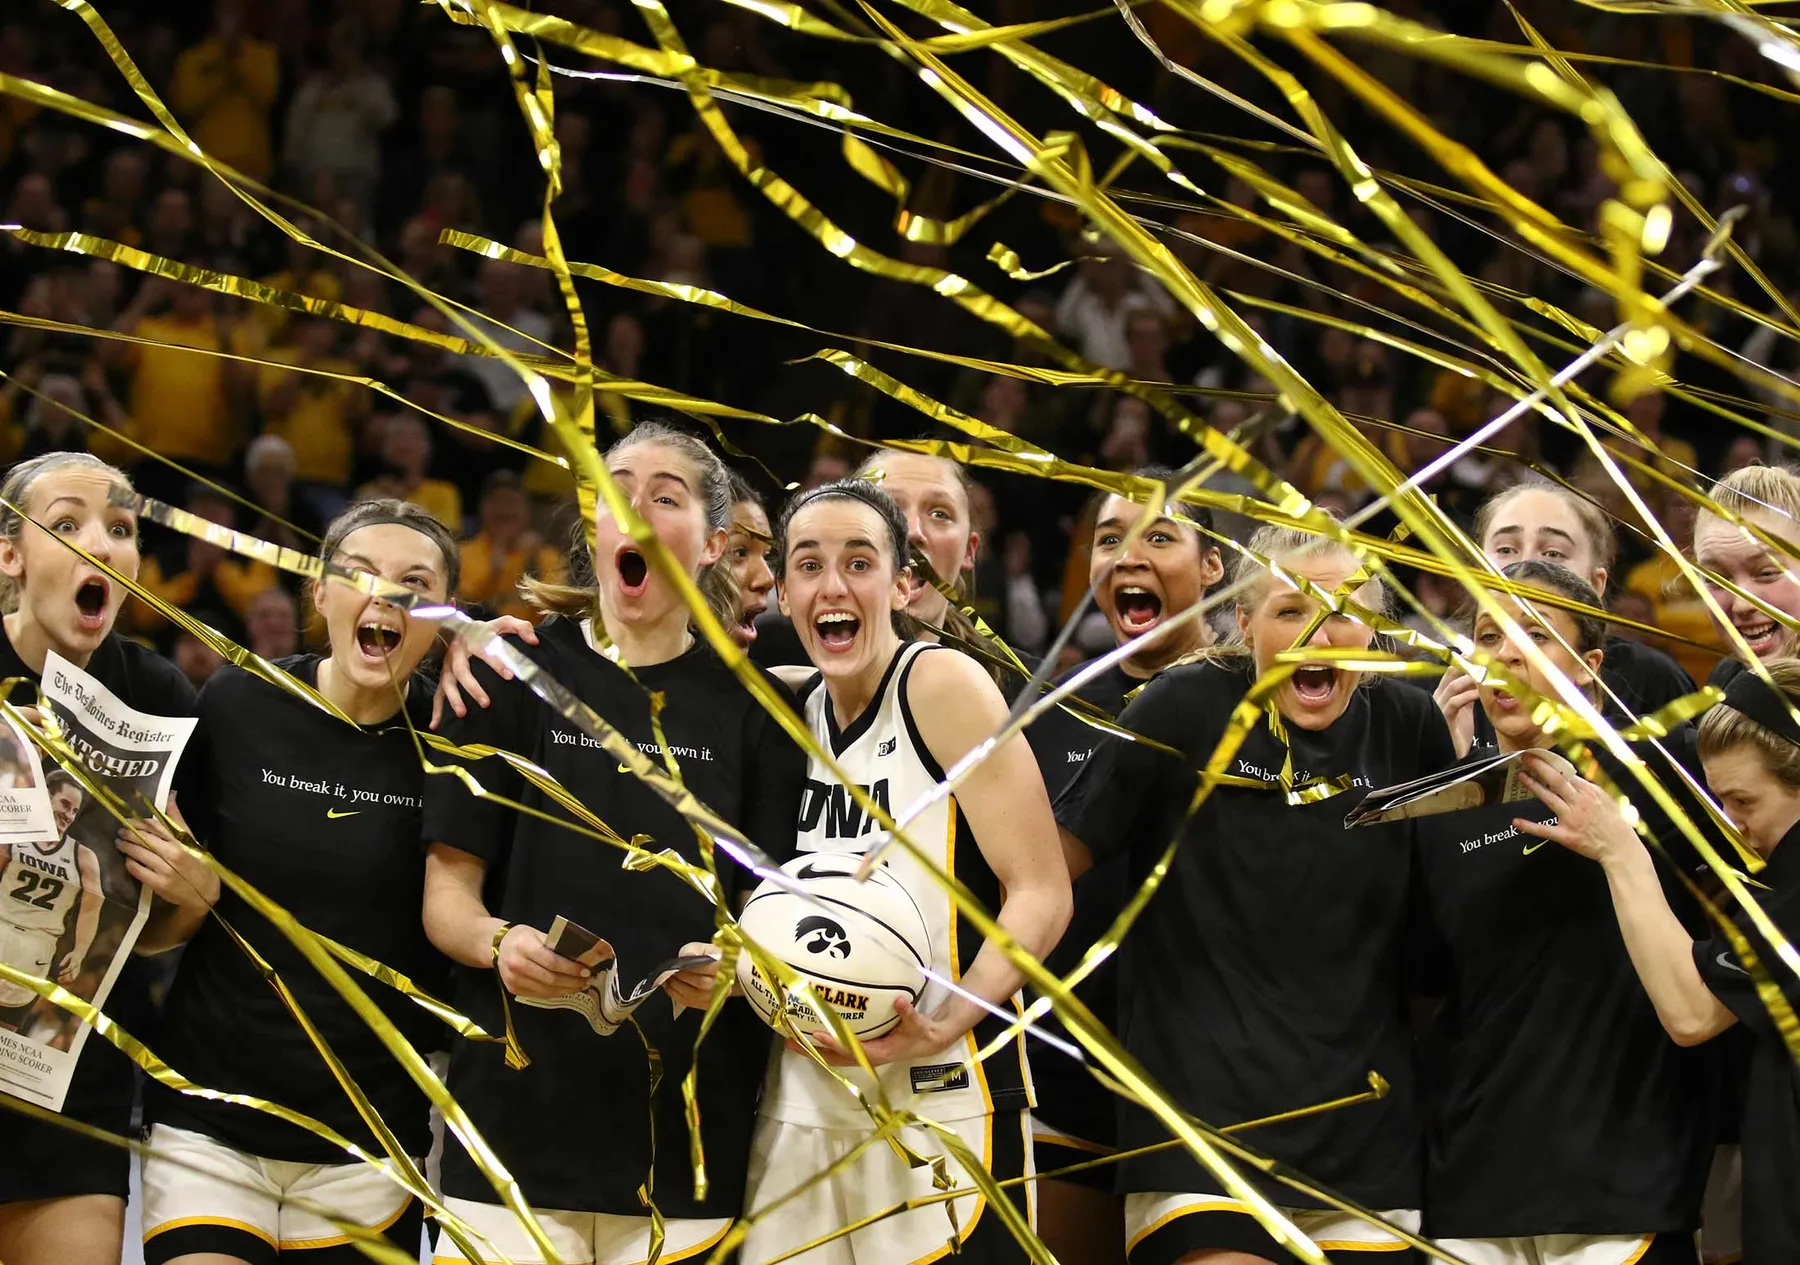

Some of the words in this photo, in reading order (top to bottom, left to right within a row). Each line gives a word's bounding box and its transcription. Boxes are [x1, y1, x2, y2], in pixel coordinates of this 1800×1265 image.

[54, 671, 73, 695] The
[75, 683, 90, 706] Des
[116, 721, 175, 744] Register
[551, 730, 576, 745] You
[580, 733, 603, 749] bre
[668, 746, 698, 761] own
[701, 747, 714, 761] it.
[1067, 751, 1086, 763] You
[1239, 760, 1262, 777] You
[261, 768, 286, 786] You
[289, 775, 331, 795] break
[334, 783, 348, 799] it,
[350, 789, 379, 803] you
[383, 793, 415, 807] own
[0, 804, 32, 813] CORER
[797, 778, 896, 839] OWA
[1460, 840, 1482, 854] You
[1484, 825, 1519, 846] break
[20, 852, 70, 881] IOWA
[10, 869, 65, 911] 22
[18, 1043, 42, 1059] NCAA
[18, 1055, 53, 1074] SCORER
[951, 1070, 961, 1082] M
